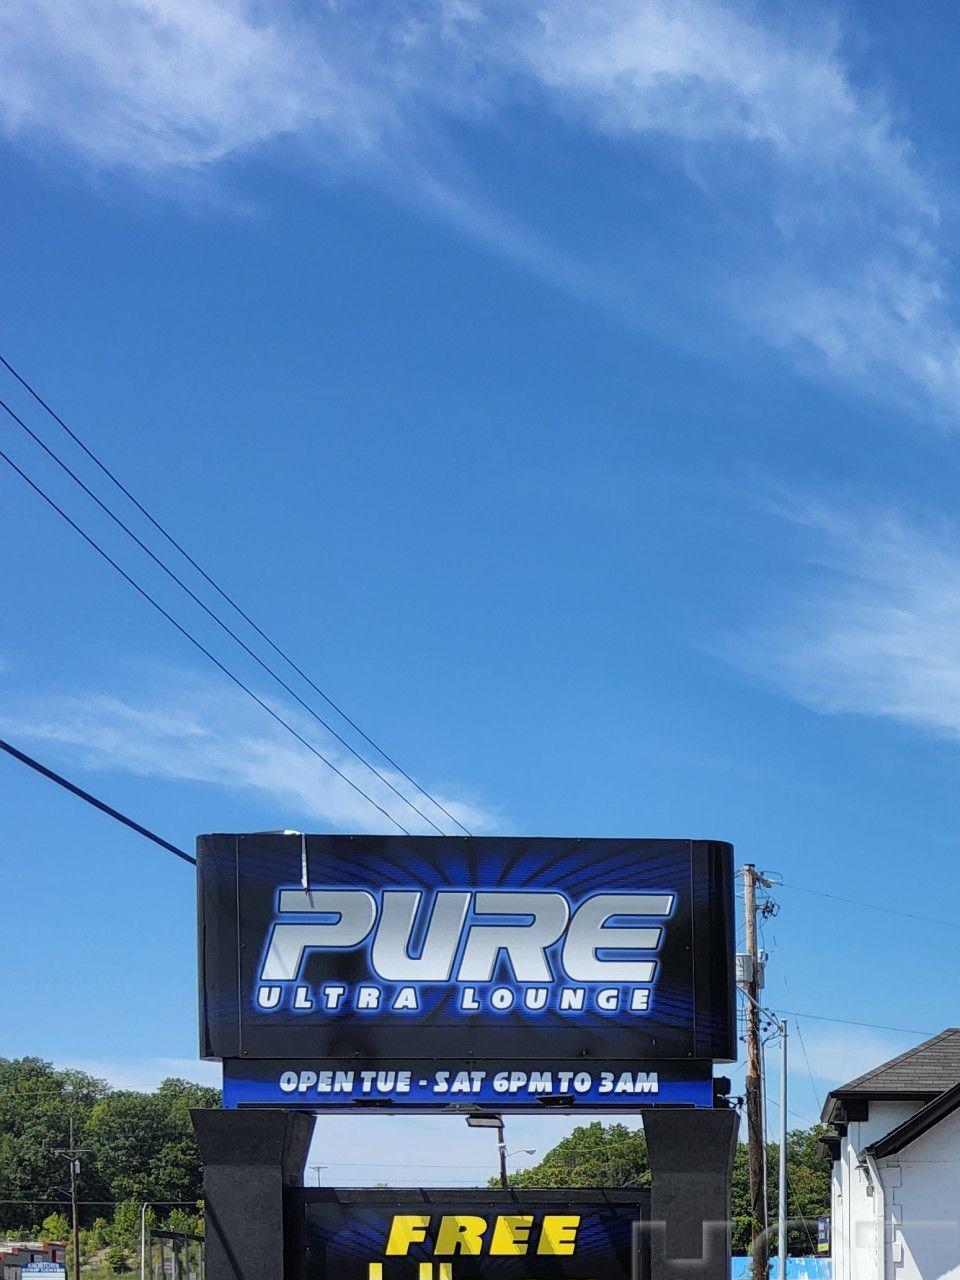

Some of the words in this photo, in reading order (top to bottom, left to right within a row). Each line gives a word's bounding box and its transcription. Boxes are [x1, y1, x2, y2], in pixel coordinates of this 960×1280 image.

[260, 890, 674, 982] PURE
[258, 987, 419, 1010] ULTRA
[462, 987, 651, 1010] LOUNGE
[280, 1070, 360, 1093] OPEN
[361, 1071, 411, 1093] TUE
[433, 1071, 487, 1093] SAT
[493, 1071, 553, 1093] 6PM
[557, 1071, 589, 1093] TO
[598, 1071, 659, 1093] 3AM
[385, 1215, 581, 1256] FREE
